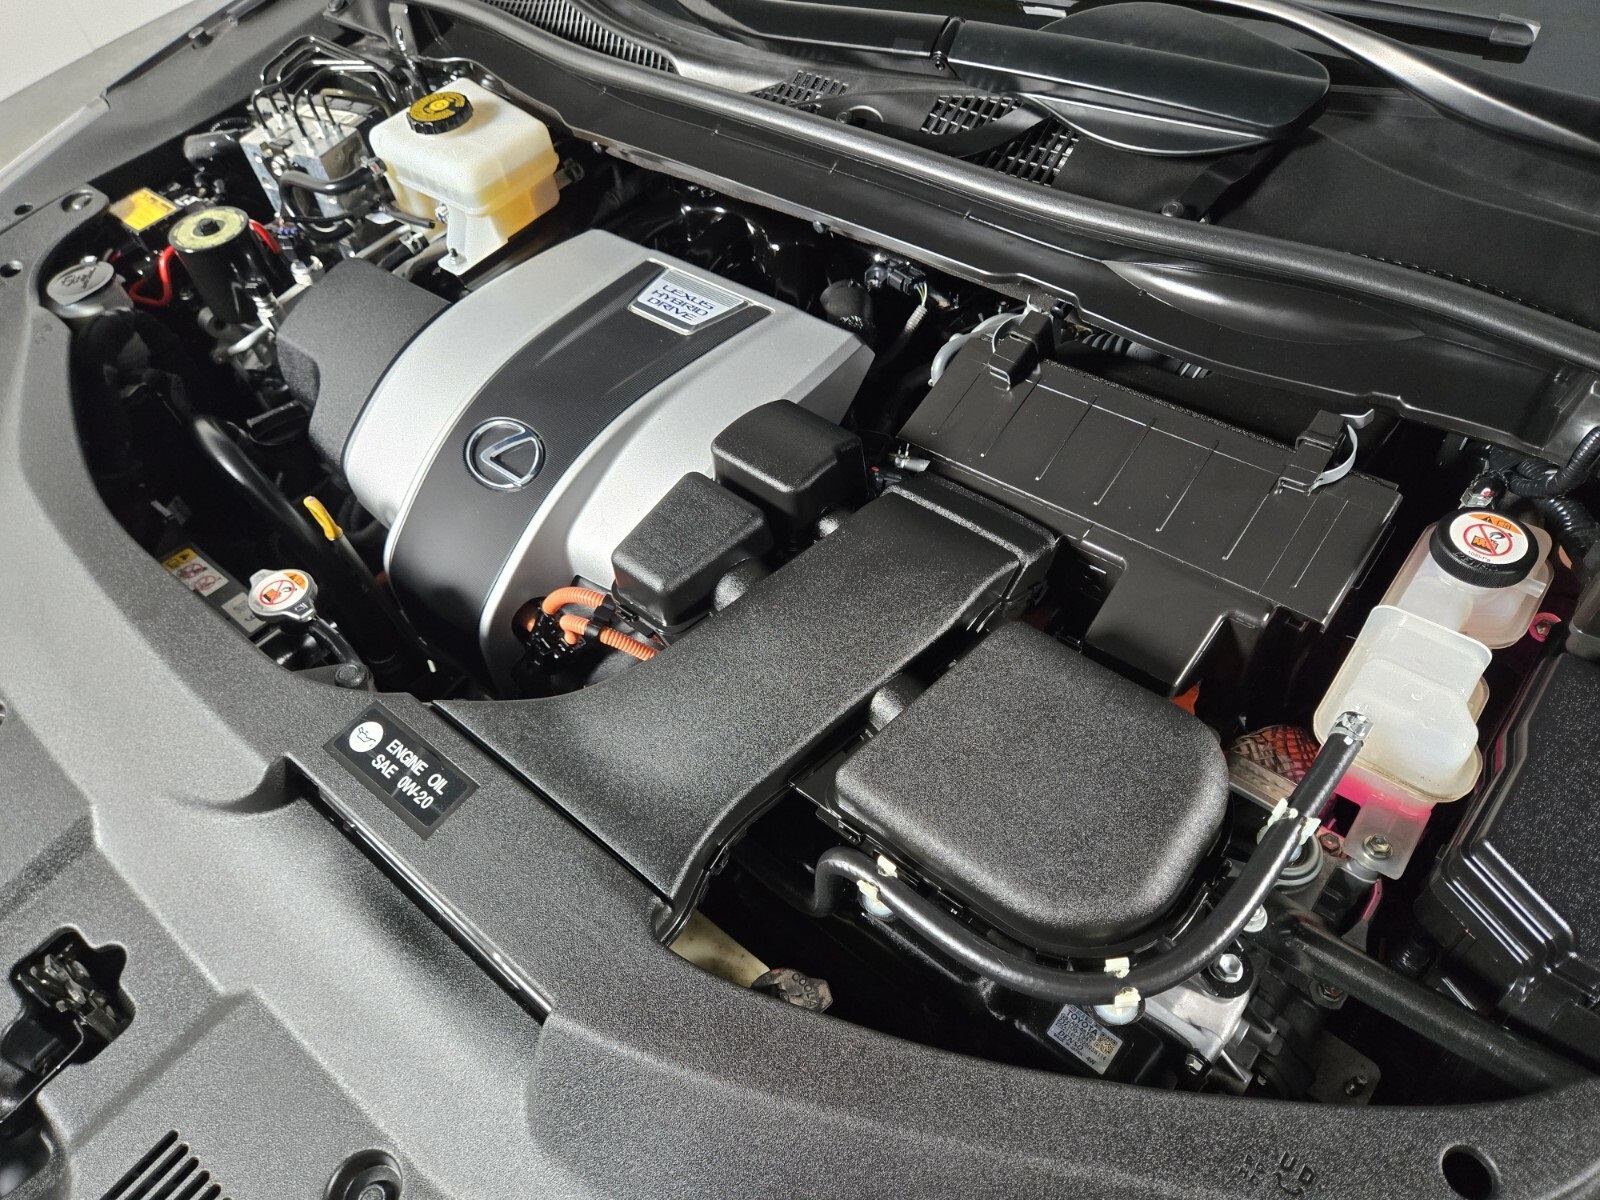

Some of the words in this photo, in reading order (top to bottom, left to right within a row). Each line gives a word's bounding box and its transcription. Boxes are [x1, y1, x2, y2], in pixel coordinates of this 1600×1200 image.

[647, 297, 698, 321] DRIVE
[651, 290, 708, 316] HYBRID
[663, 285, 714, 310] LEXUS
[385, 739, 429, 776] ENGINE
[427, 773, 448, 795] OIL
[371, 754, 399, 779] SAE
[397, 776, 434, 809] 0W-20
[791, 972, 818, 1010] COOLA
[1067, 1010, 1098, 1036] TOYOTA
[1058, 1030, 1084, 1050] DENSO
